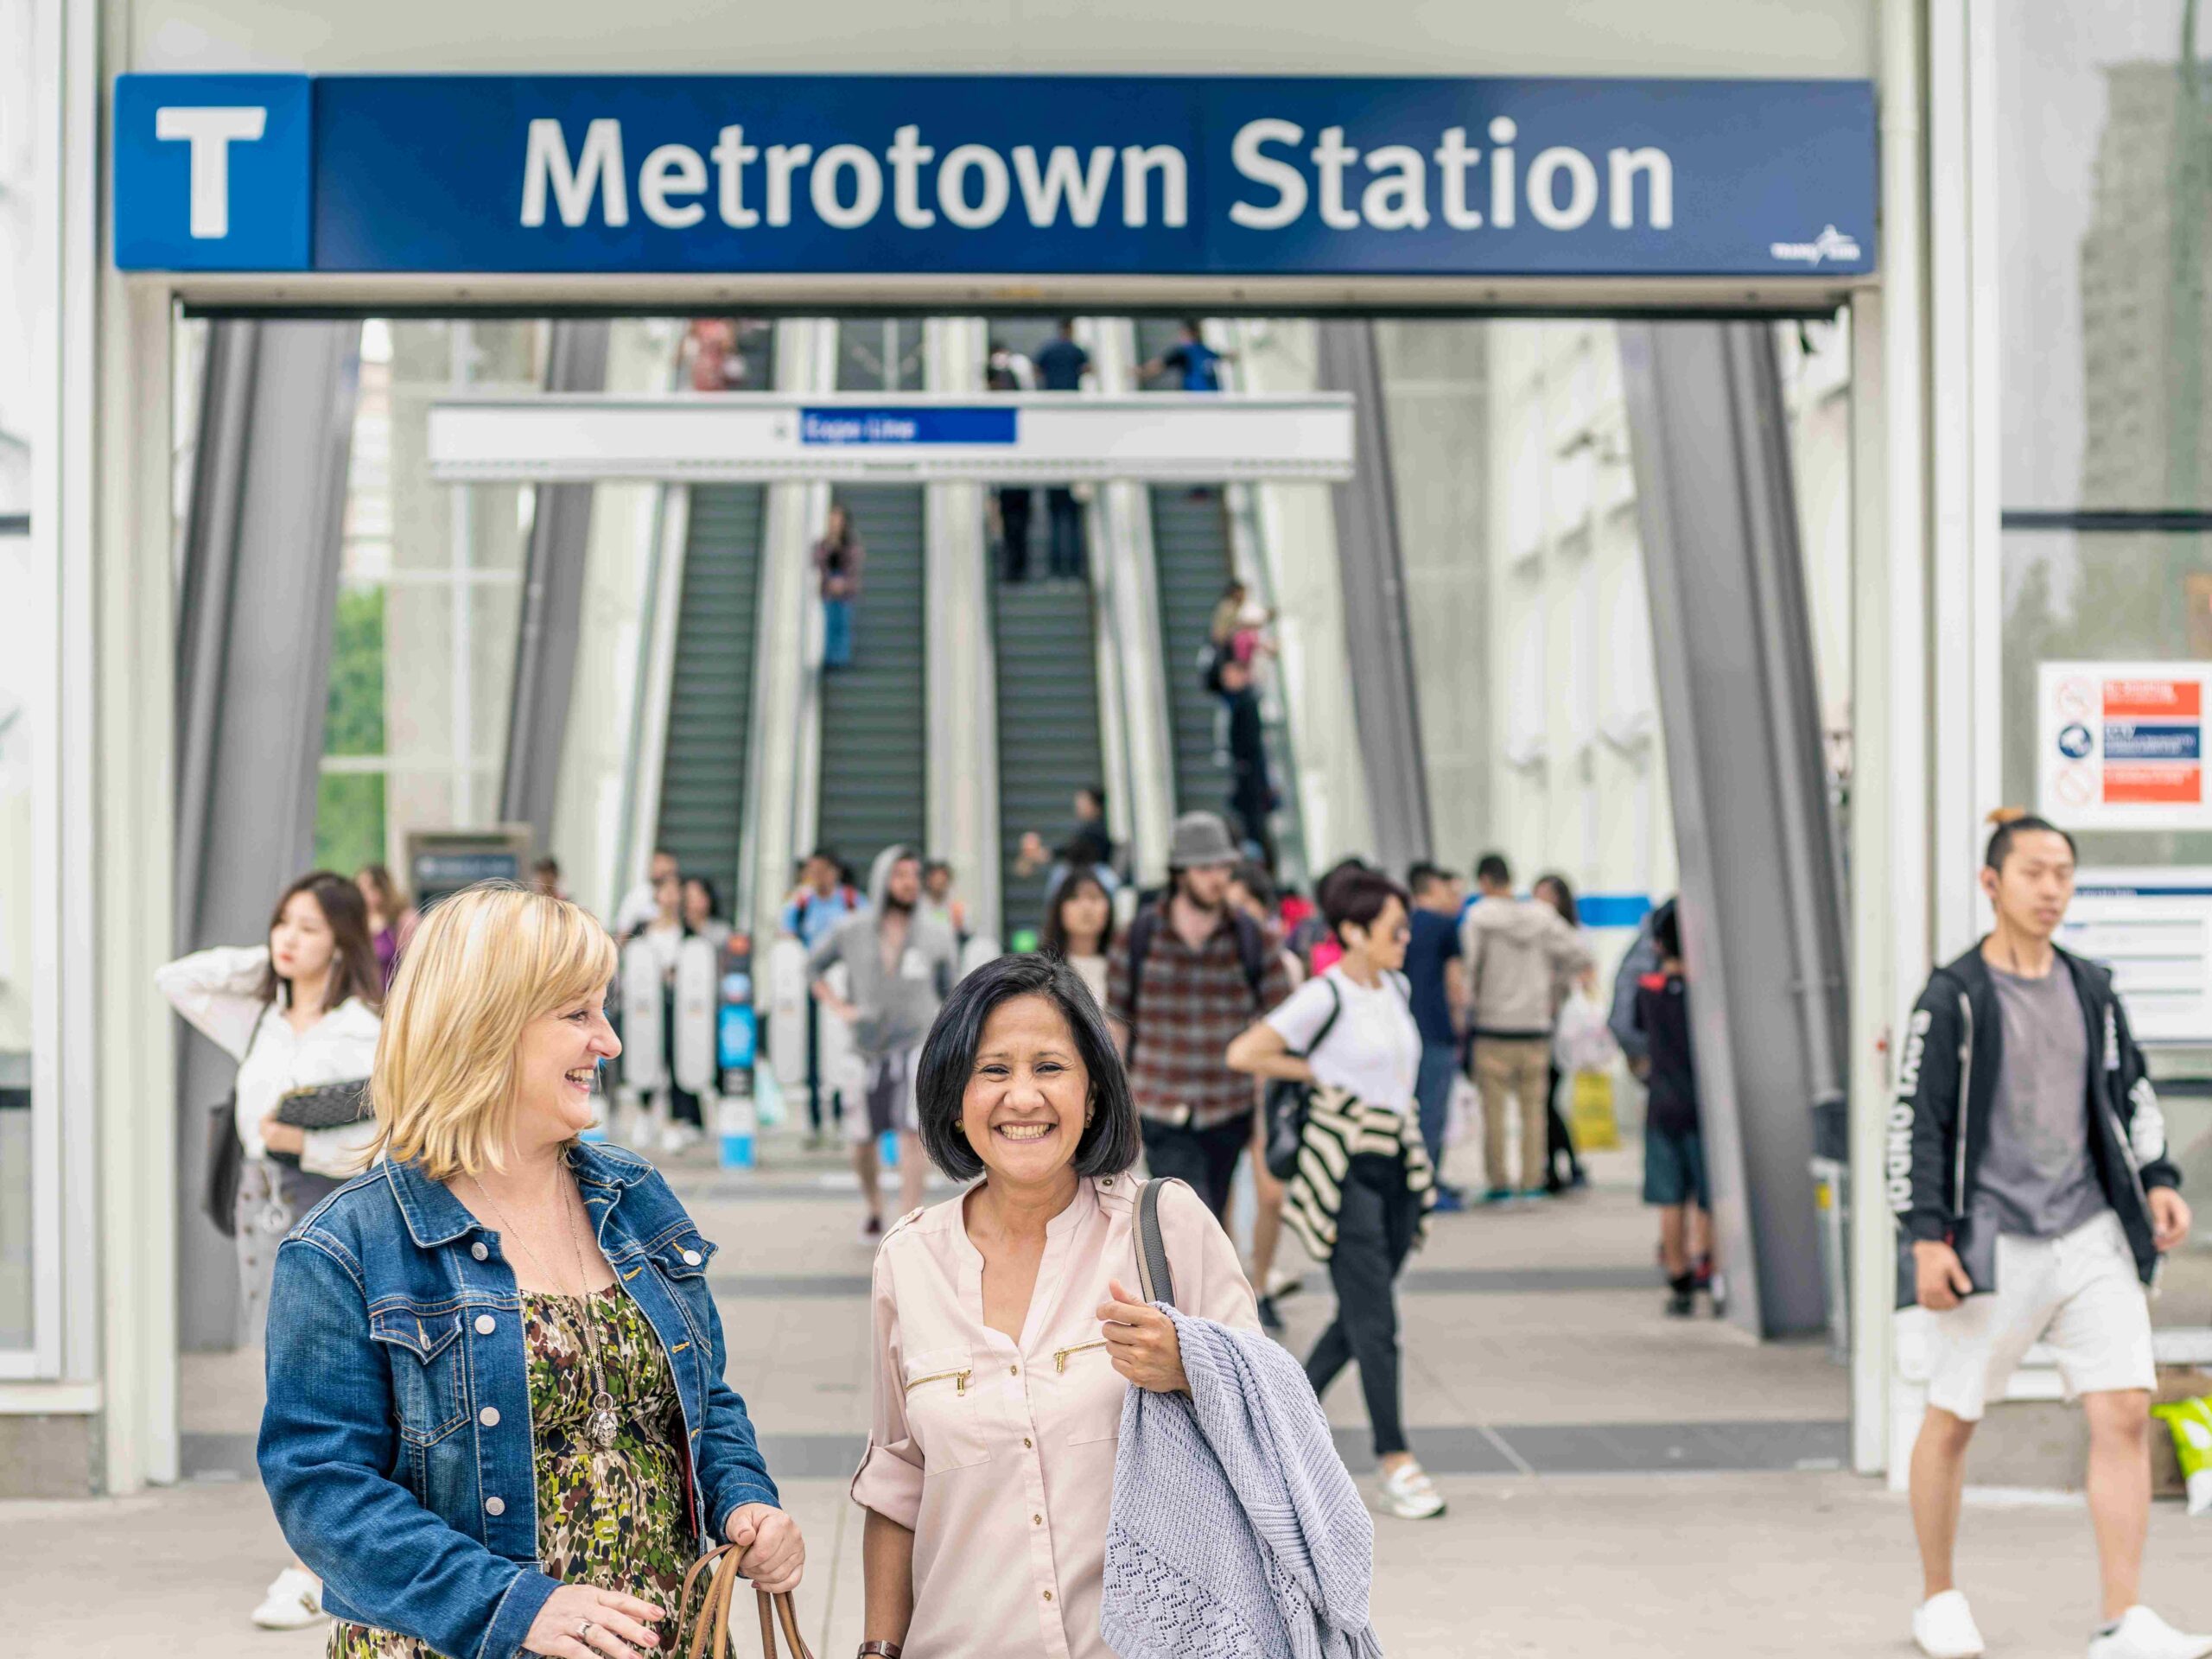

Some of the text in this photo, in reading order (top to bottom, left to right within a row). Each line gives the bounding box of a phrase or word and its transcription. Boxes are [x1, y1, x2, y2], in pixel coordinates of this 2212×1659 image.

[156, 106, 266, 238] T
[521, 116, 1674, 232] Metrotown Station
